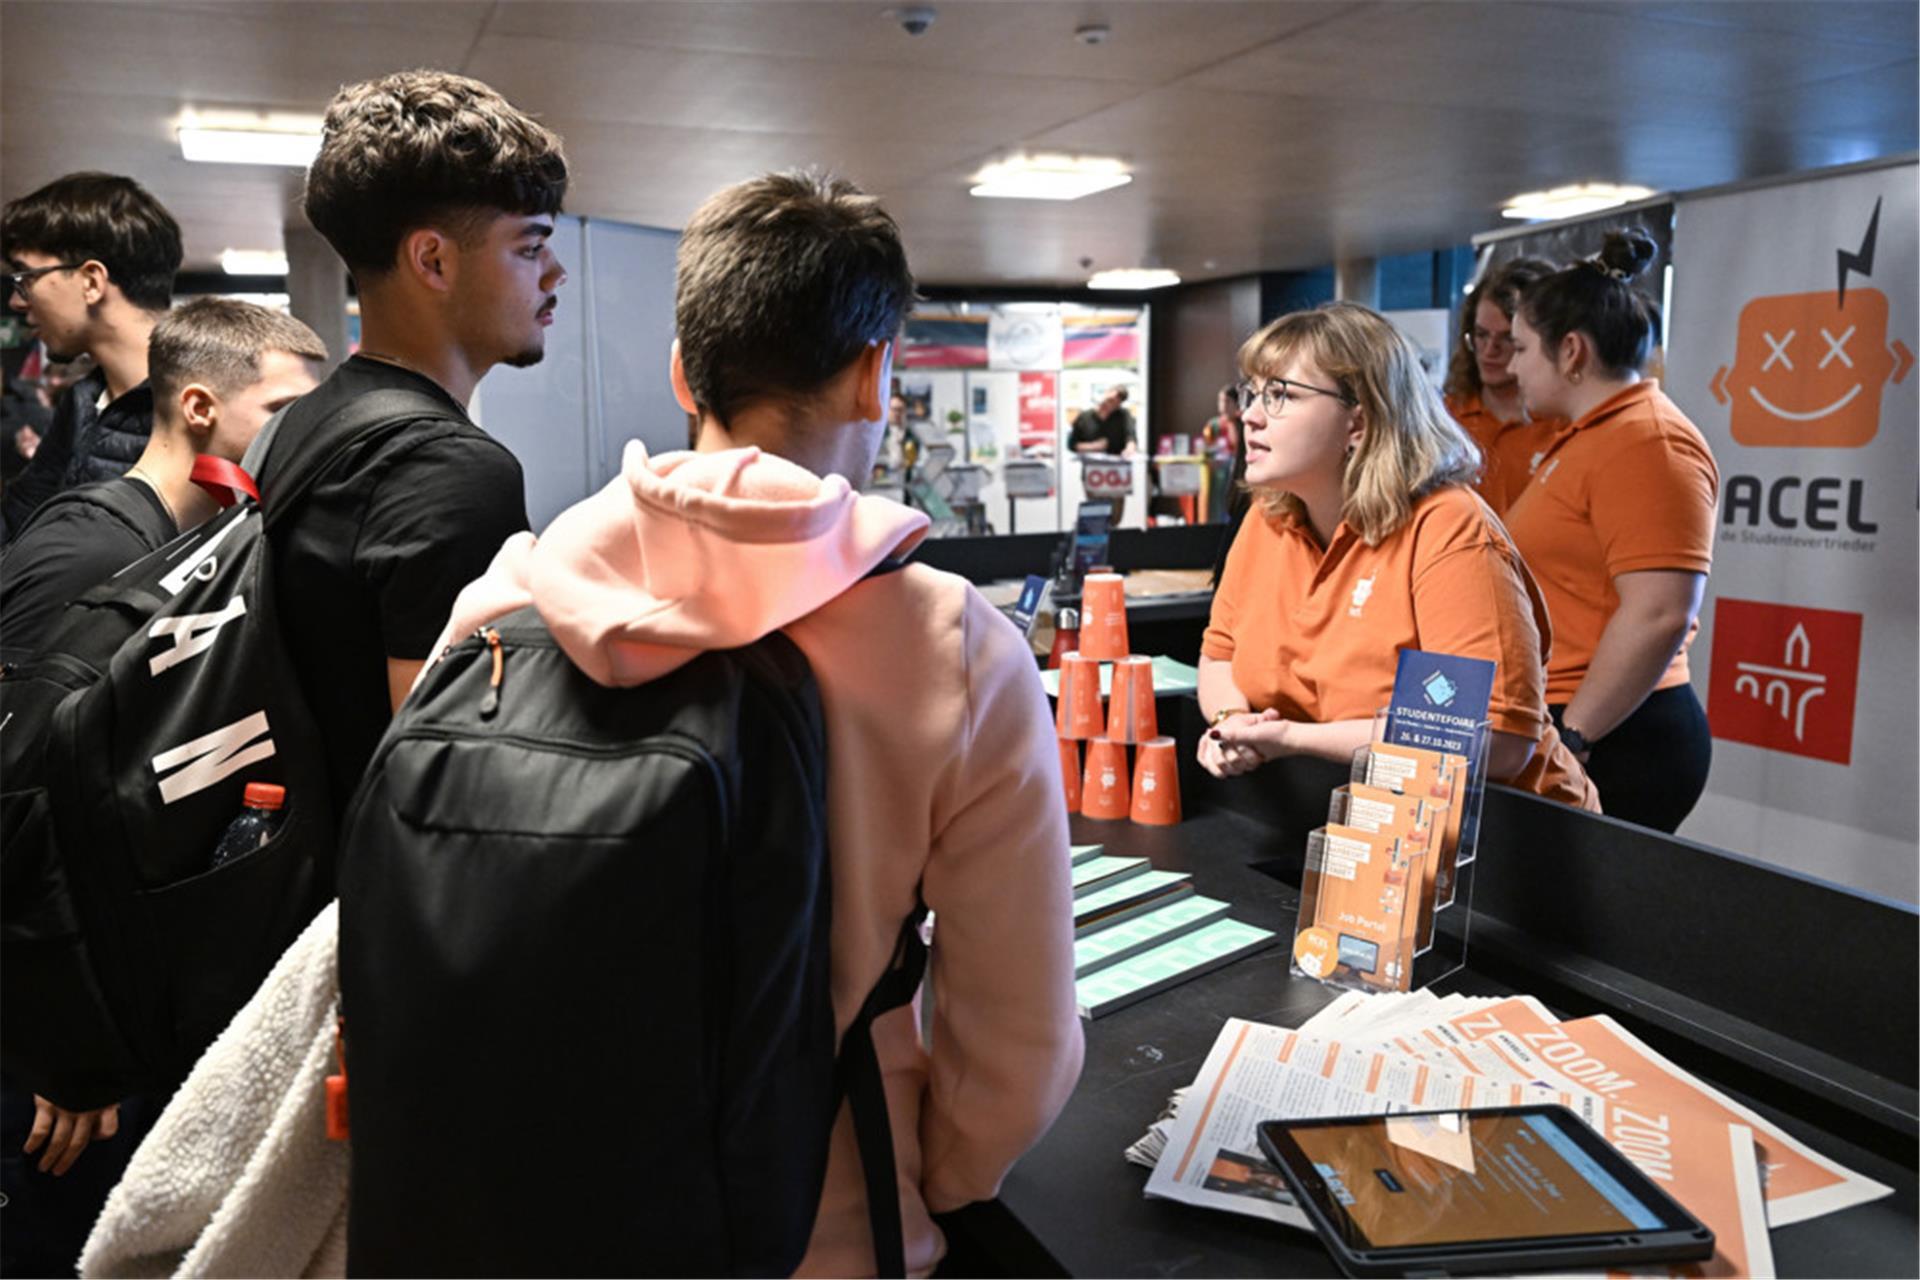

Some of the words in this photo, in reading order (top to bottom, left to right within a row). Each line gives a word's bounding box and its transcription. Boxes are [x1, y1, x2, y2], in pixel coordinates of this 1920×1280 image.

[1723, 475, 1878, 534] ACEL
[1721, 531, 1736, 543] de
[1396, 706, 1476, 728] STUDENTEFOIRE
